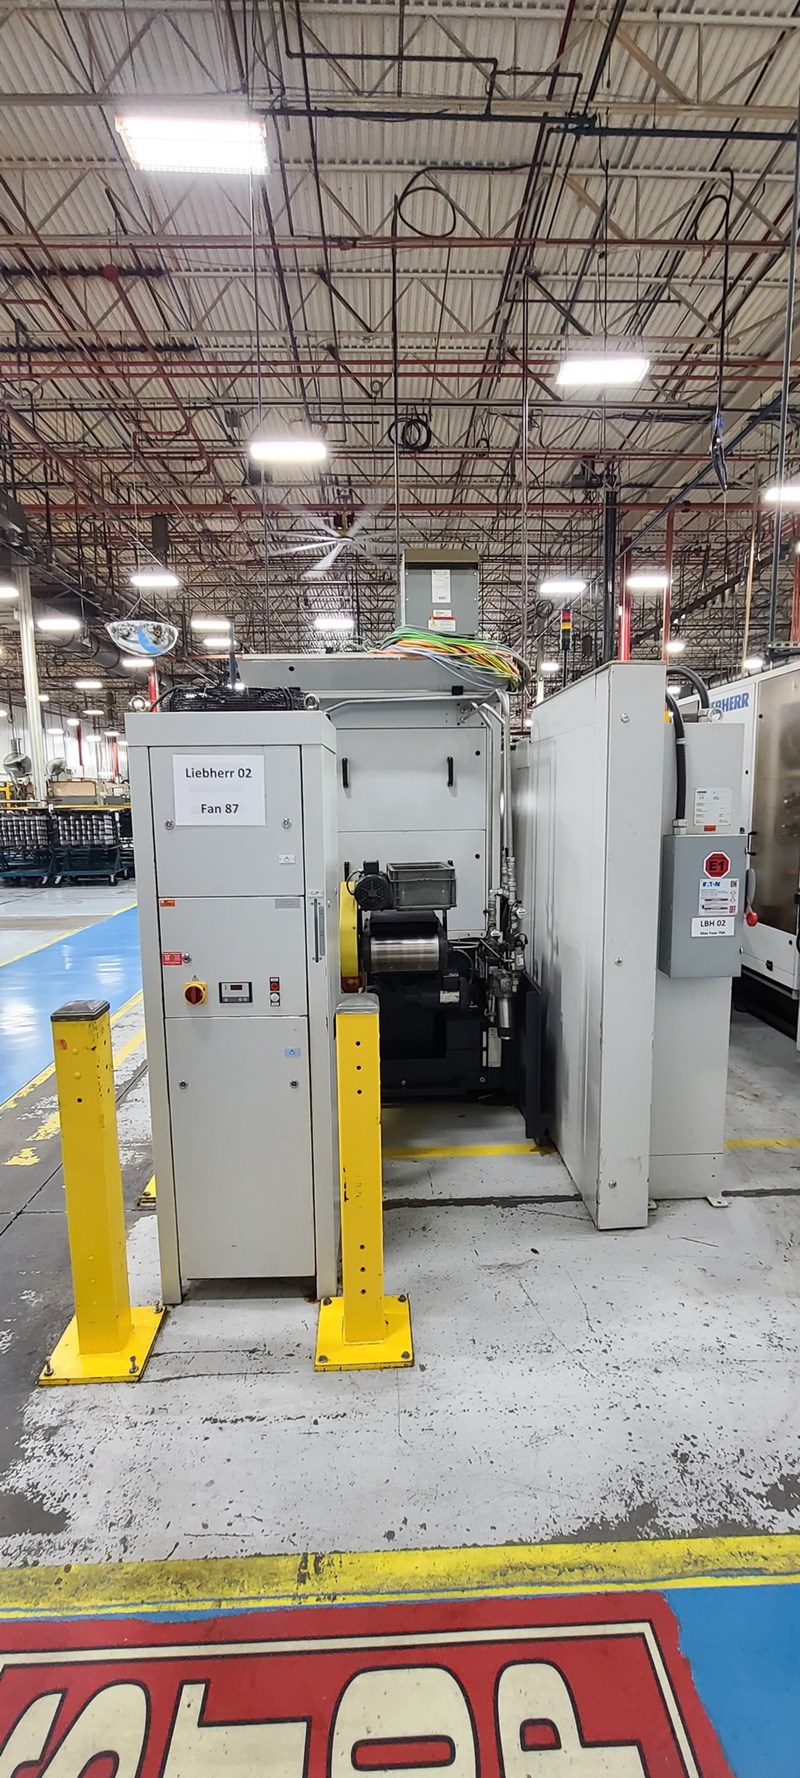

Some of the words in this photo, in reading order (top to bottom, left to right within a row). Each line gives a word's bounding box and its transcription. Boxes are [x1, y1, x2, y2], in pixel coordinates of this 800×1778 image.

[710, 692, 749, 712] EBHERR
[185, 767, 235, 778] Liebherr
[237, 768, 252, 778] 02
[201, 803, 222, 814] Fan
[225, 803, 239, 814] 87
[709, 860, 725, 871] E1
[700, 920, 715, 928] LBH
[716, 919, 726, 927] 02
